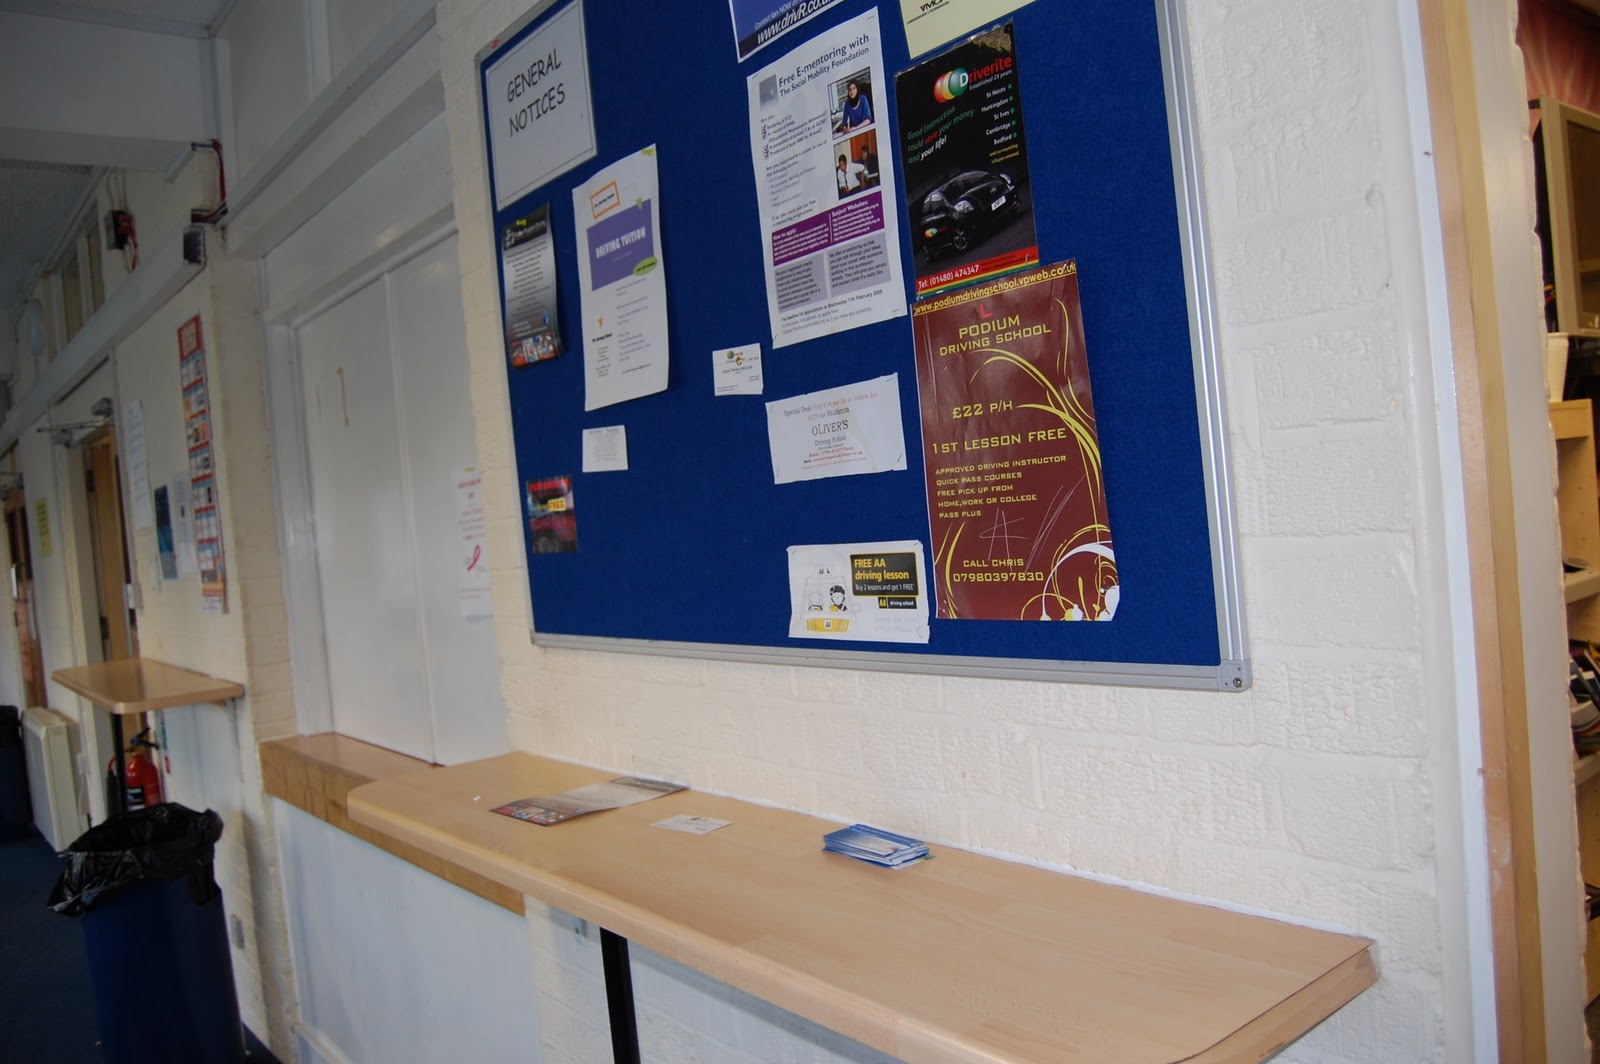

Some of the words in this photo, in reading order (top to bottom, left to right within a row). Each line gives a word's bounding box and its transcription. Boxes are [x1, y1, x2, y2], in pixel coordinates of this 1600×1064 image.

[757, 0, 832, 44] www.drivR.co.u
[778, 74, 796, 88] Free
[796, 46, 847, 77] E-mentoring
[848, 33, 869, 51] with
[507, 48, 562, 103] GENERAL
[780, 87, 791, 97] The
[791, 77, 807, 92] Social
[807, 65, 830, 82] Mobility
[831, 47, 869, 69] Foundation
[959, 56, 1012, 88] Driverite
[999, 69, 1013, 80] years
[992, 86, 1006, 96] Neots
[509, 83, 565, 138] NOTICES
[981, 98, 1009, 113] Huntingdon
[907, 126, 923, 140] Good
[923, 106, 956, 133] Instruction
[907, 138, 924, 152] could
[924, 131, 939, 145] save
[938, 121, 952, 137] your
[953, 109, 975, 123] money
[985, 121, 1011, 136] Cambridge
[993, 133, 1012, 146] Bedford
[907, 151, 920, 164] and
[920, 146, 934, 161] your
[934, 134, 947, 150] life!
[595, 238, 621, 259] DRIVING
[621, 226, 646, 247] TUITION
[918, 279, 929, 289] Tel:
[929, 271, 954, 287] (01480)
[954, 264, 979, 278] 474347
[914, 262, 1077, 314] www.podiumdrivingschool.vpweb.co.uk
[979, 303, 992, 318] L
[959, 314, 1021, 340] PODIUM
[939, 337, 990, 356] DRIVING
[995, 323, 1052, 344] SCHOOL
[783, 405, 800, 418] Special
[800, 403, 812, 413] Deal
[826, 407, 850, 418] Students
[952, 403, 984, 420] £22
[989, 400, 1013, 413] P/H
[811, 419, 849, 437] OLIVER'S
[814, 436, 831, 447] Driving
[832, 434, 847, 444] School
[932, 442, 958, 454] 1ST
[964, 433, 1022, 451] LESSON
[1028, 427, 1067, 443] FREE
[935, 464, 975, 475] APPROVED
[977, 461, 1010, 471] DRIVING
[1012, 455, 1067, 467] INSTRUCTOR
[936, 478, 959, 487] QUICK
[961, 475, 982, 484] PASS
[984, 471, 1022, 482] COURSES
[937, 489, 956, 497] FREE
[958, 487, 976, 496] PICK
[977, 486, 989, 494] UP
[991, 484, 1014, 493] FROM
[986, 496, 998, 504] OR
[1000, 494, 1038, 503] COLLEGE
[939, 511, 960, 519] PASS
[961, 509, 982, 518] PLUS
[854, 558, 872, 568] FREE
[873, 558, 886, 568] AA
[963, 559, 988, 568] CALL
[991, 558, 1024, 568] CHRIS
[855, 570, 882, 582] driving
[883, 570, 909, 580] lesson
[953, 571, 1044, 582] 07980397830
[855, 584, 863, 592] Buy
[867, 583, 881, 591] lessons
[890, 584, 899, 592] get
[879, 598, 887, 607] AA
